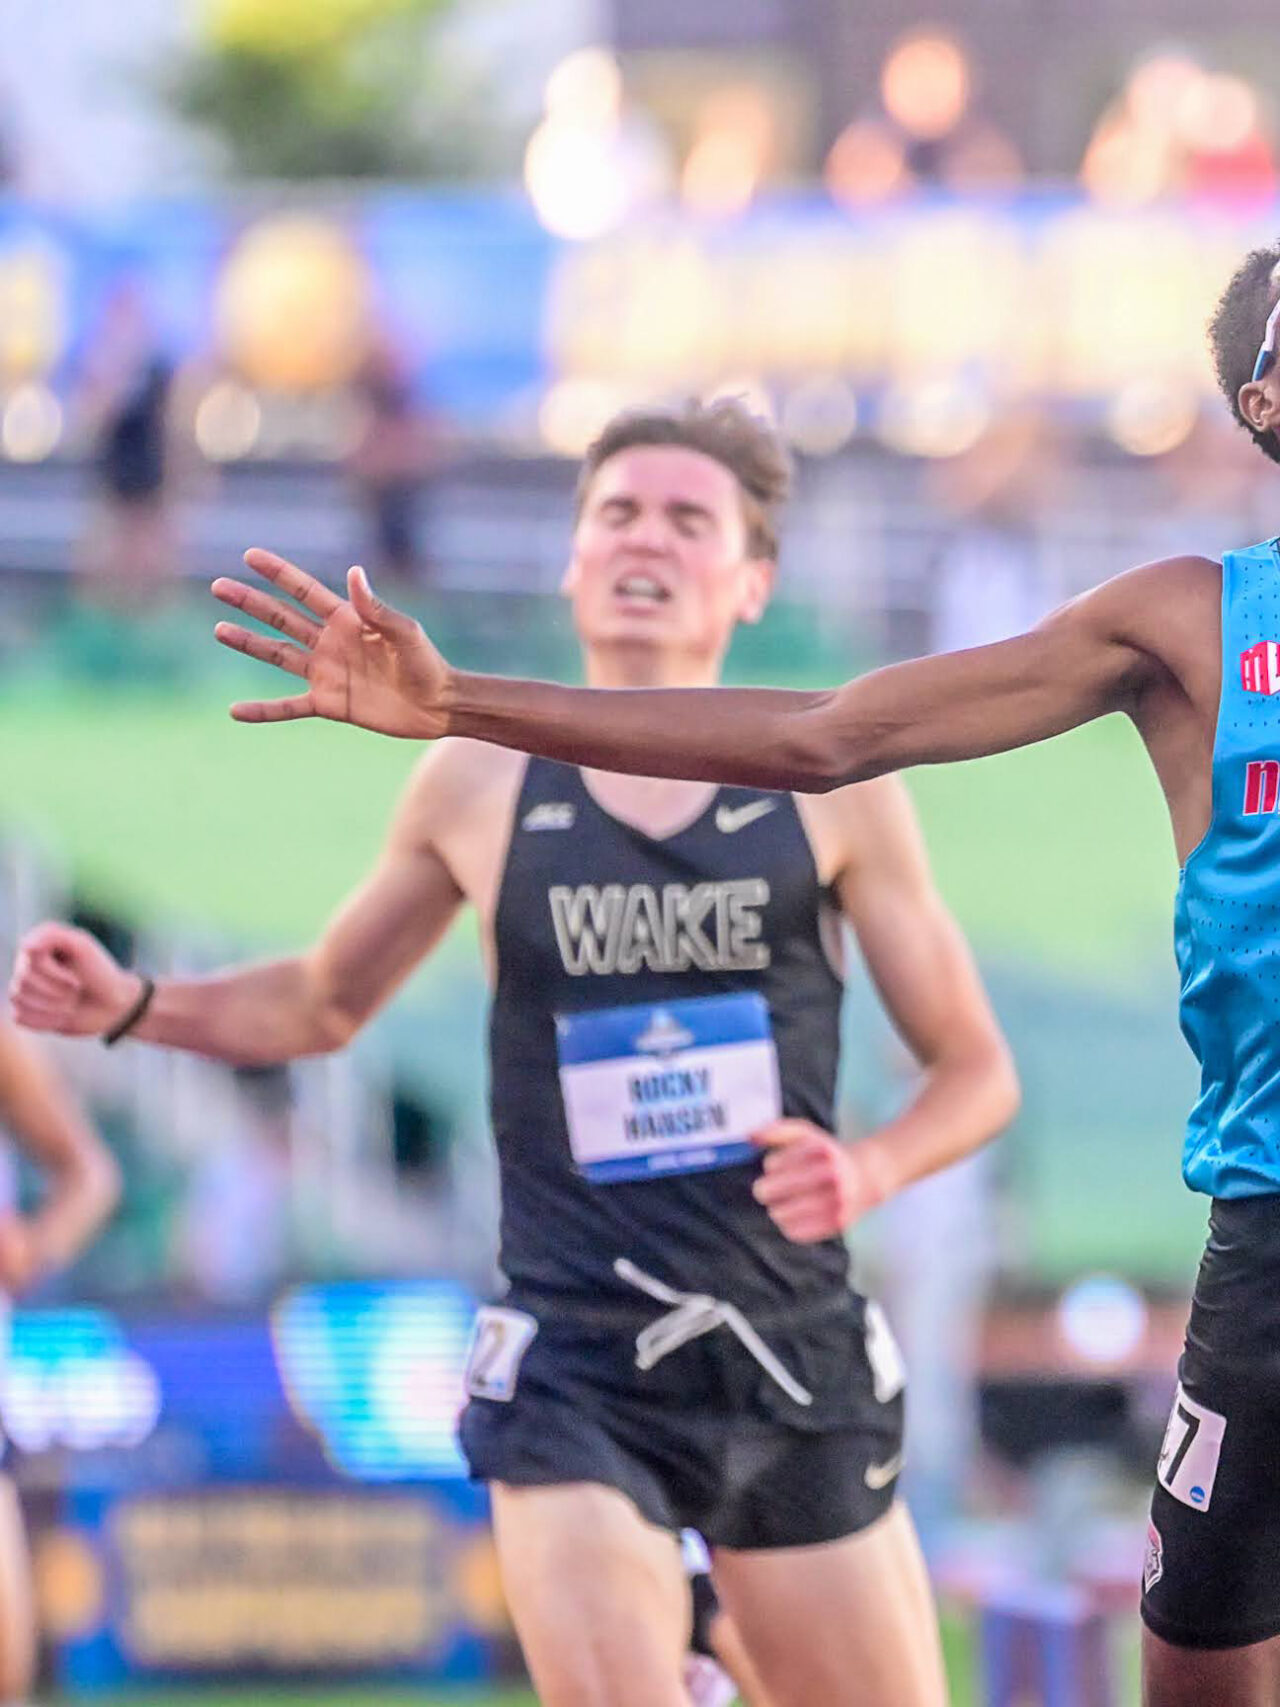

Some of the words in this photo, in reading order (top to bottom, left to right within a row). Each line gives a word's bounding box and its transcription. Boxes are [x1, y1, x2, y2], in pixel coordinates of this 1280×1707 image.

[548, 877, 771, 976] WAKE
[629, 1068, 709, 1103] ROCKY
[624, 1102, 727, 1141] HANSEN
